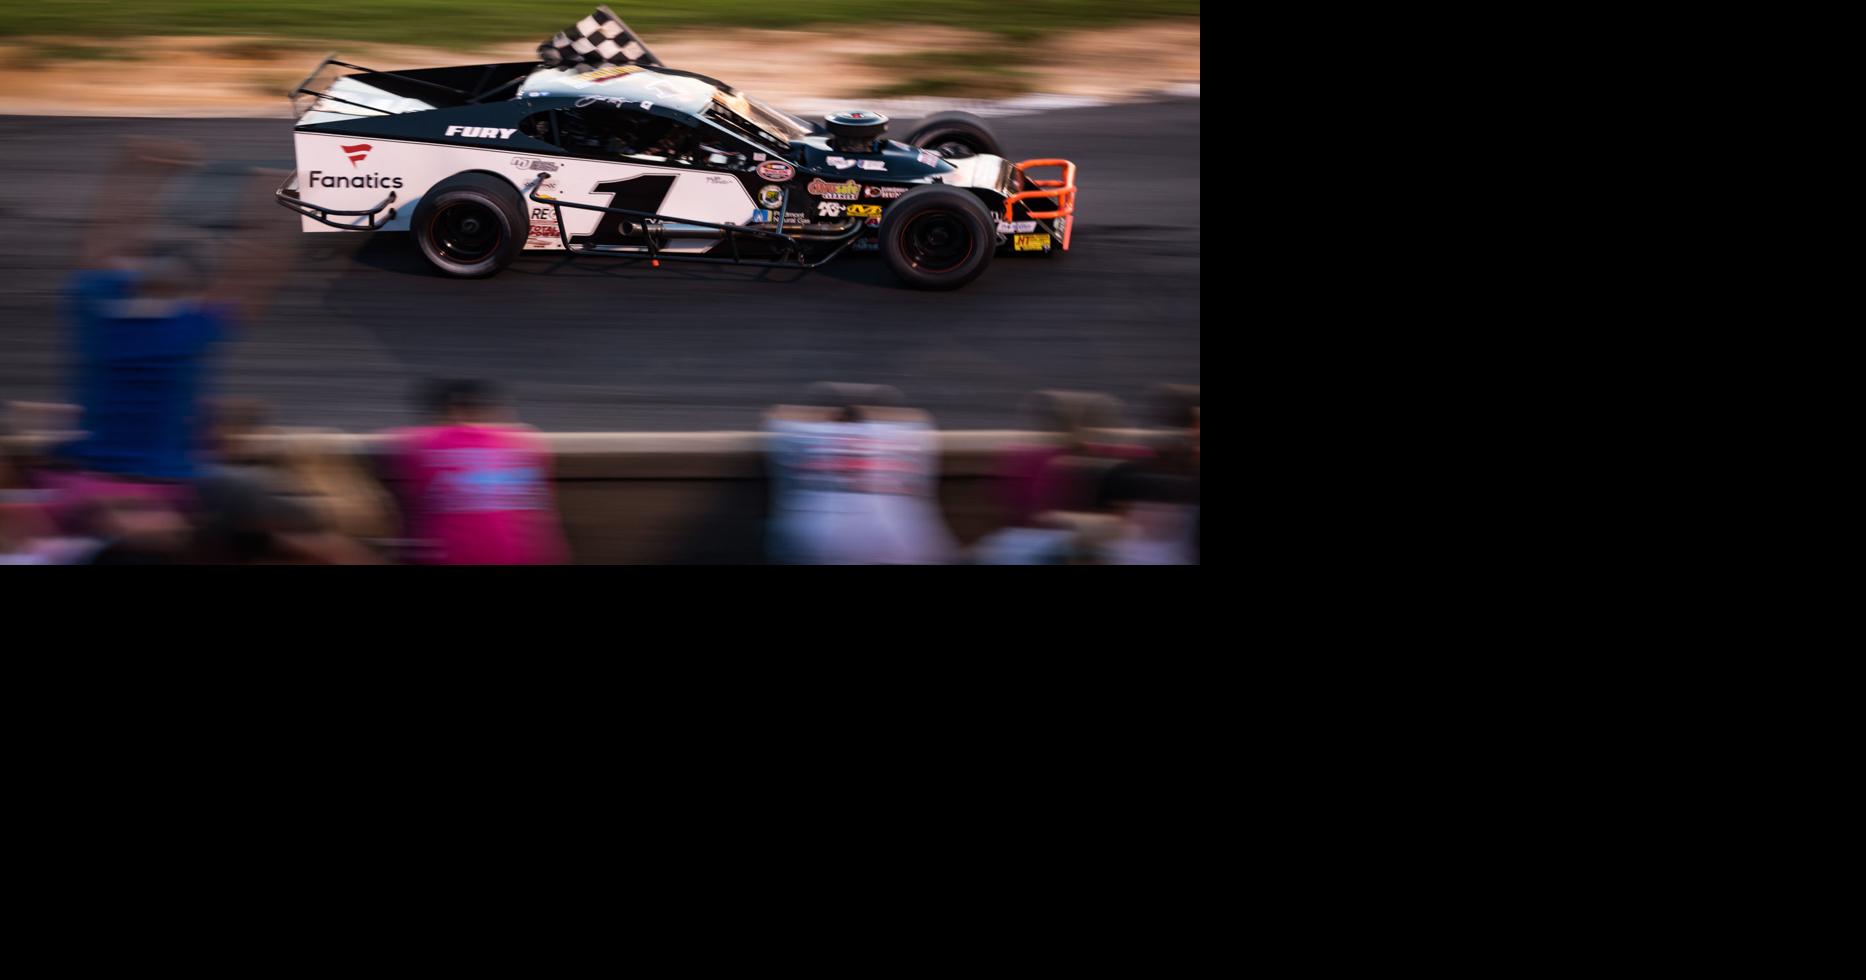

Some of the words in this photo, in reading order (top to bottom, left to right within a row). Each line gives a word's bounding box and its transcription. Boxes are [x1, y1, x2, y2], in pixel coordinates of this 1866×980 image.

[445, 125, 518, 139] FURY
[309, 171, 403, 188] Fanatics
[567, 173, 681, 245] 1
